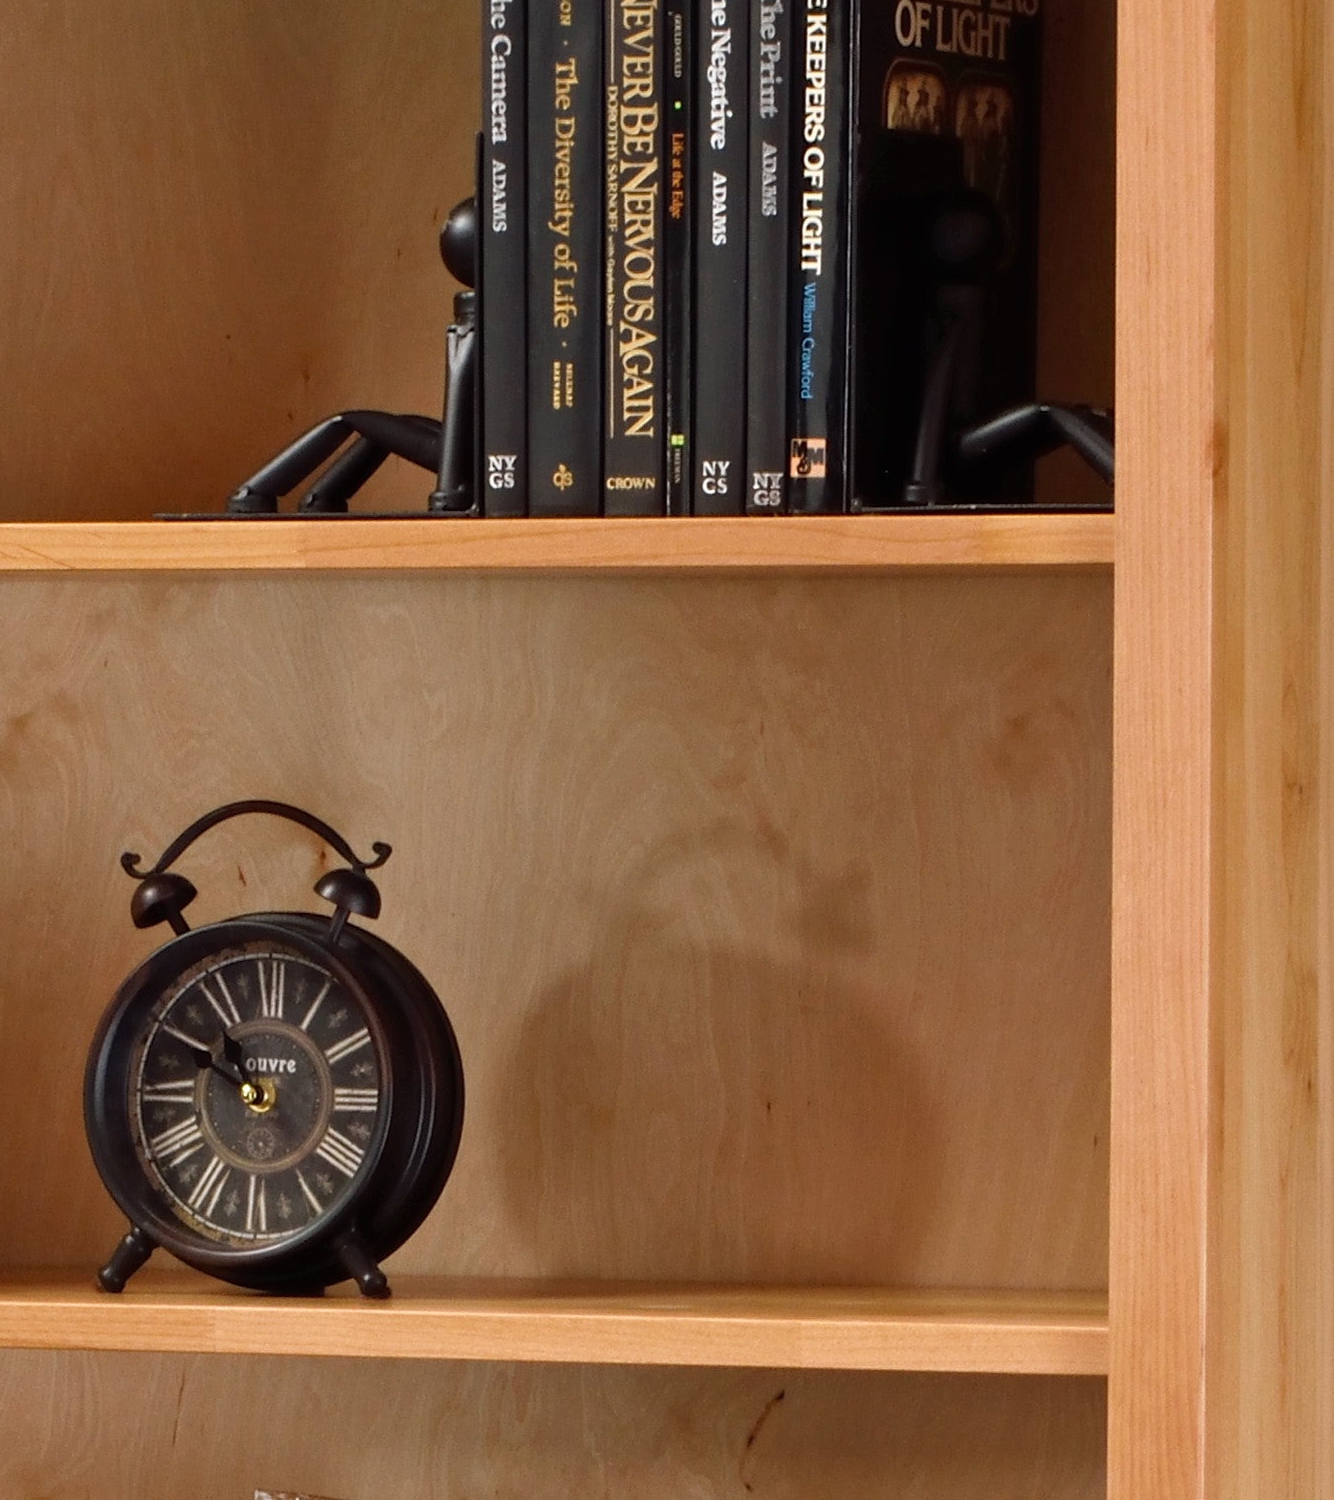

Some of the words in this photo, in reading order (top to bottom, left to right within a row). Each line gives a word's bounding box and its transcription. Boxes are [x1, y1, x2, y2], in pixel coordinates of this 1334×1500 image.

[935, 4, 1011, 61] LIGHT
[491, 33, 512, 143] Camera
[555, 57, 579, 110] The
[707, 28, 733, 150] Negative
[760, 41, 783, 119] Print
[803, 13, 827, 143] KEEPERS
[606, 86, 618, 162] DOROTHY
[620, 102, 658, 156] BE
[672, 132, 684, 156] Life
[548, 117, 575, 237] Diversity
[672, 158, 683, 168] at
[672, 169, 684, 188] the
[761, 141, 777, 217] ADAMS
[802, 146, 825, 190] OF
[492, 159, 507, 233] ADAMS
[606, 163, 618, 232] SARNOFF
[669, 190, 684, 219] Edge
[712, 171, 727, 246] ADAMS
[552, 243, 578, 274] of
[619, 156, 658, 322] NERVOUS
[800, 191, 824, 276] LIGHT
[552, 277, 577, 329] Life
[802, 282, 816, 333] William
[619, 320, 658, 438] AGAIN
[800, 337, 816, 400] Crawford
[488, 454, 516, 471] NY
[606, 477, 656, 490] CROWN
[702, 461, 731, 477] NY
[753, 472, 784, 489] NY
[233, 1057, 297, 1073] ouvre
